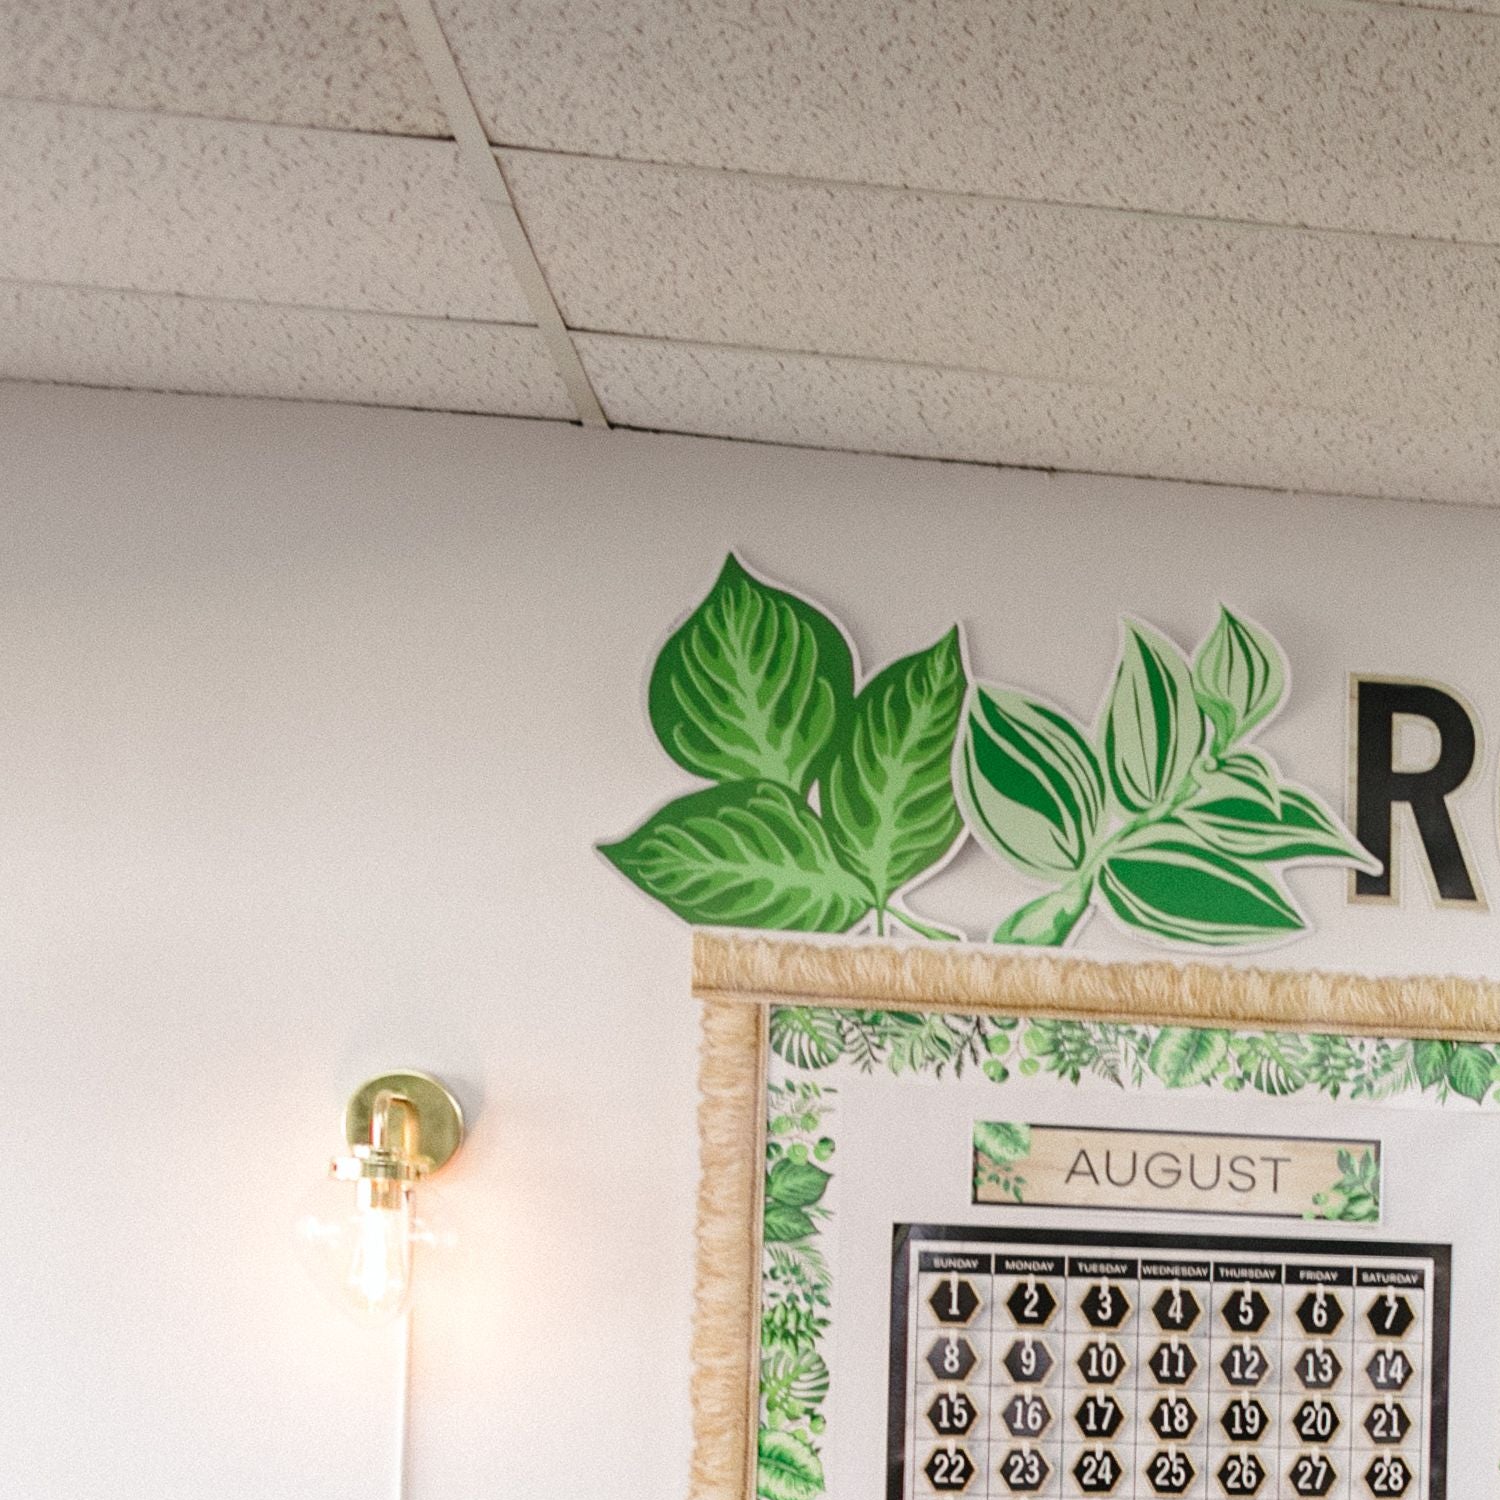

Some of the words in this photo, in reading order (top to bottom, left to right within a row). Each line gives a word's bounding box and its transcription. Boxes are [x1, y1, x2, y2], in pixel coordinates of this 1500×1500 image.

[1064, 1149, 1291, 1194] AUGUST
[932, 1257, 979, 1269] SUNDAY
[1005, 1260, 1054, 1272] MONDAY
[1077, 1262, 1128, 1275] TUESDAY
[1142, 1265, 1208, 1277] WEDNESDAY
[1219, 1267, 1276, 1280] THURSDAY
[1299, 1269, 1338, 1282] FRIDAY
[1361, 1271, 1418, 1285] SATURDAY
[948, 1286, 960, 1315] 1
[1024, 1289, 1039, 1317] 2
[1097, 1291, 1112, 1321] 3
[1168, 1296, 1182, 1324] 4
[1238, 1297, 1254, 1325] 5
[1312, 1299, 1327, 1328] 6
[1385, 1300, 1399, 1329] 7
[944, 1344, 960, 1373] 8
[1021, 1346, 1036, 1375] 9
[1088, 1347, 1117, 1377] 10
[1159, 1349, 1186, 1378] 11
[1231, 1350, 1259, 1380] 12
[1305, 1353, 1333, 1383] 13
[1376, 1355, 1404, 1384] 14
[939, 1399, 968, 1428] 15
[1013, 1401, 1042, 1430] 16
[1086, 1402, 1115, 1431] 17
[1160, 1403, 1189, 1432] 18
[1231, 1404, 1260, 1434] 19
[1302, 1406, 1332, 1436] 20
[1372, 1408, 1400, 1437] 21
[933, 1454, 965, 1484] 22
[1009, 1455, 1040, 1484] 23
[1082, 1456, 1113, 1485] 24
[1155, 1456, 1186, 1486] 25
[1226, 1459, 1257, 1489] 26
[1298, 1460, 1327, 1490] 27
[1373, 1462, 1403, 1491] 28
